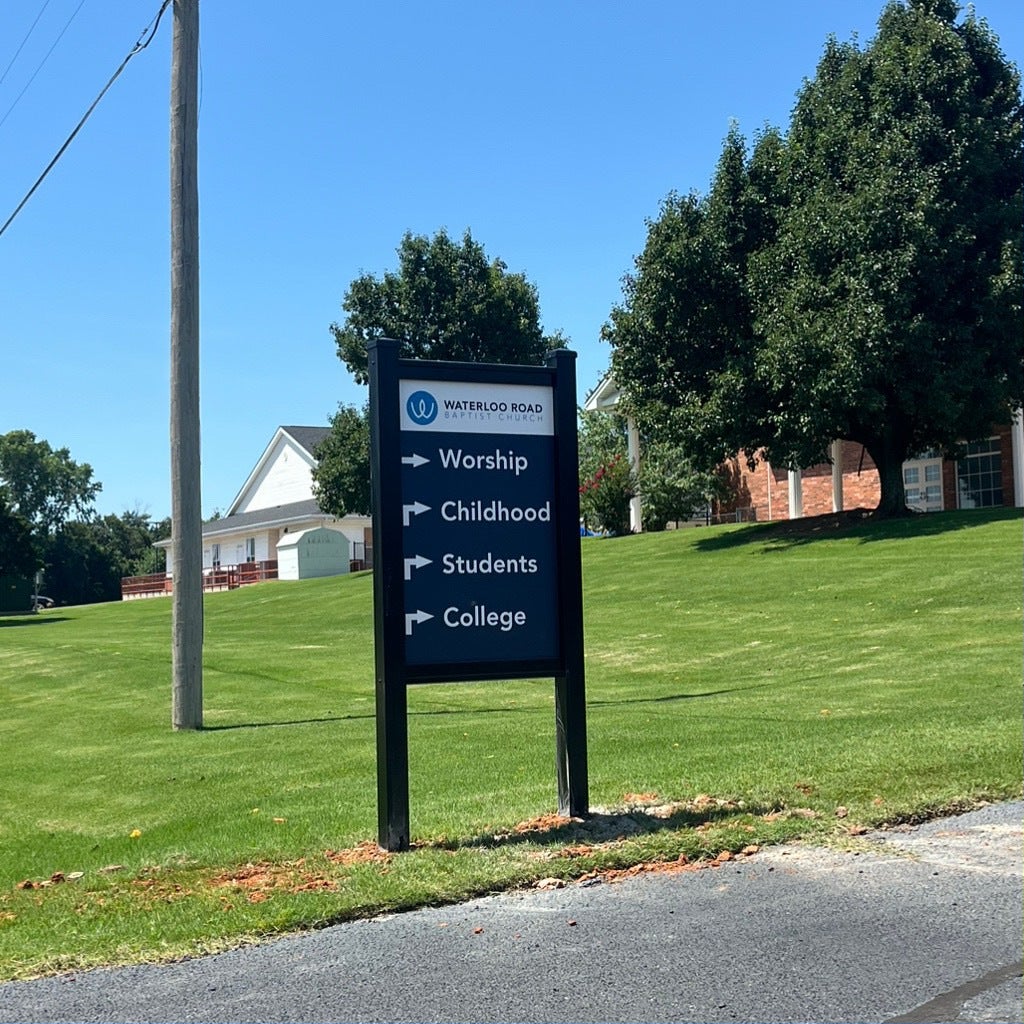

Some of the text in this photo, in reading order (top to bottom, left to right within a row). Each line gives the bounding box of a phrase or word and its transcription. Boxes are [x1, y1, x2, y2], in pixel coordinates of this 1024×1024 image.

[443, 400, 543, 413] WATERLOO ROAD
[444, 411, 543, 422] BAPTIST CHURCH
[439, 448, 528, 475] Worship
[440, 500, 550, 522] Childhood
[442, 552, 538, 574] Students
[443, 605, 527, 631] College
